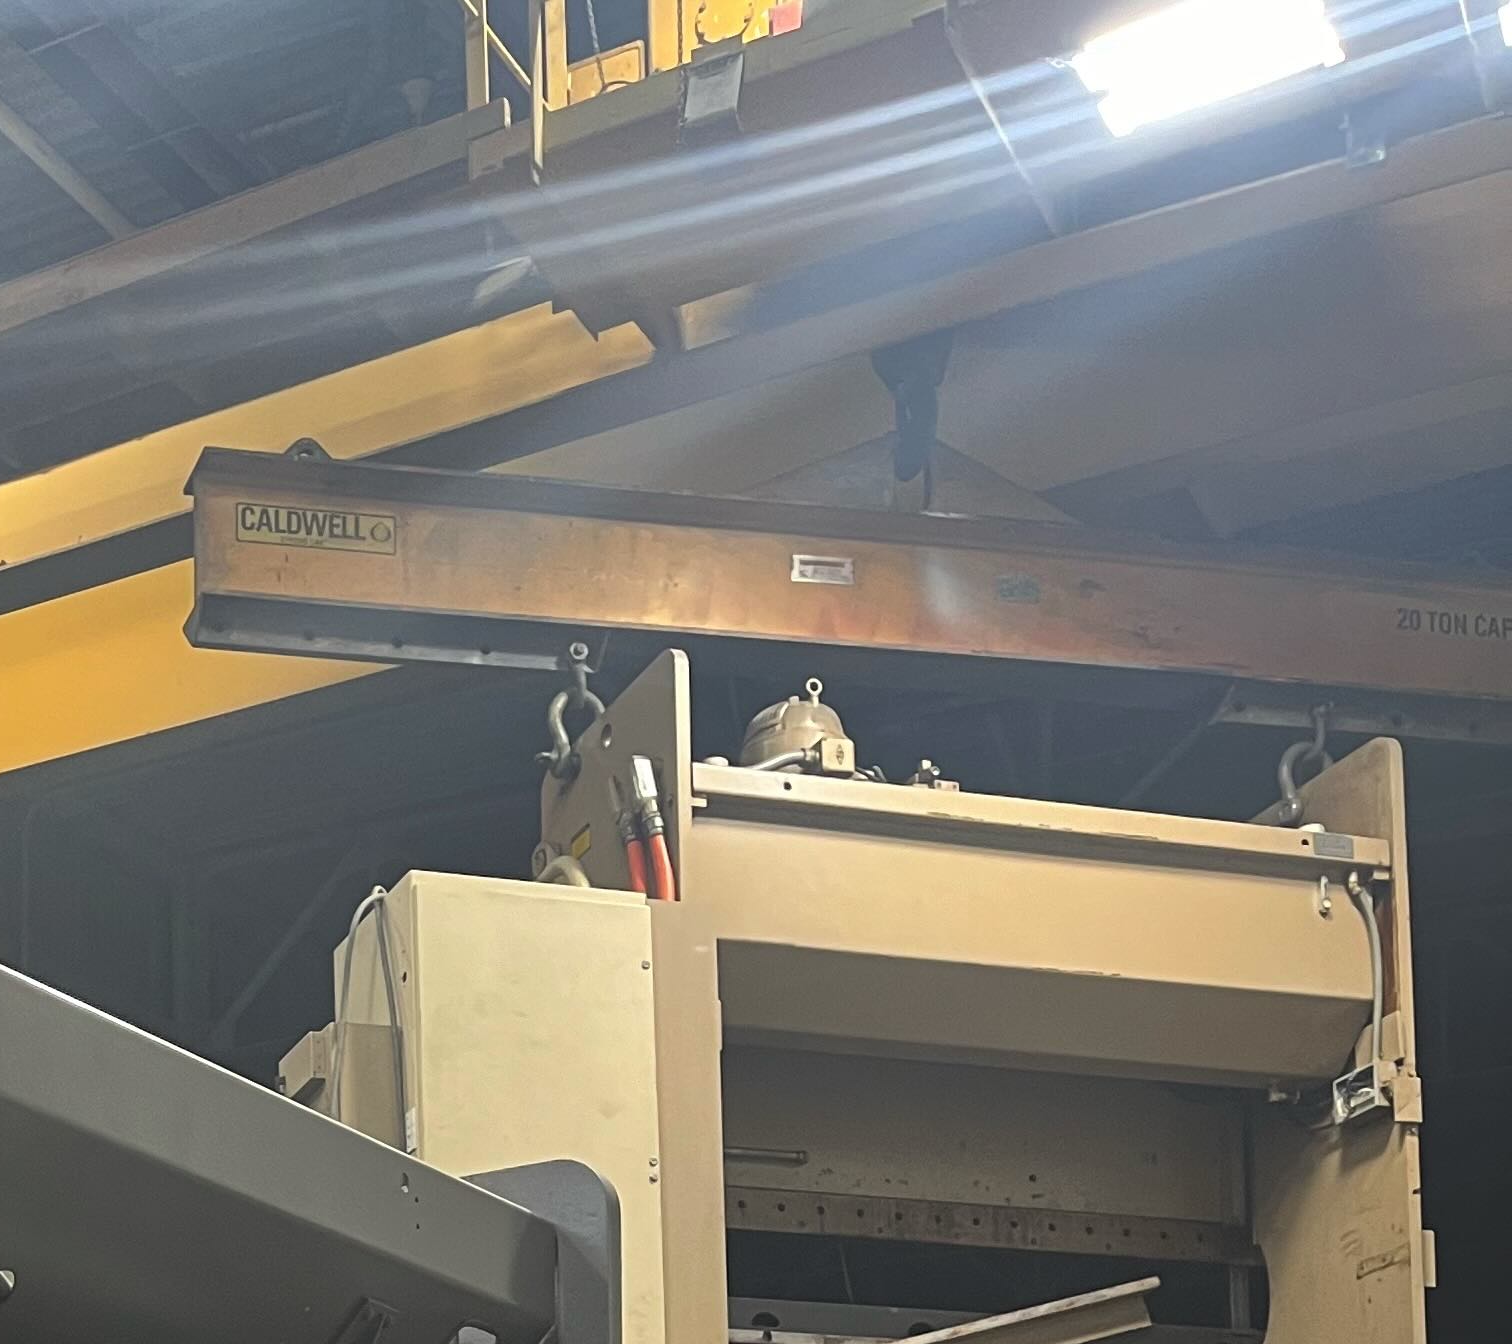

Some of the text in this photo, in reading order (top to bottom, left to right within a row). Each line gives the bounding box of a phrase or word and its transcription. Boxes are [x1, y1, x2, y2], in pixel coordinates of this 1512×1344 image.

[240, 505, 366, 541] CALDWELL
[1396, 607, 1421, 632] 20
[1427, 609, 1467, 636] TON
